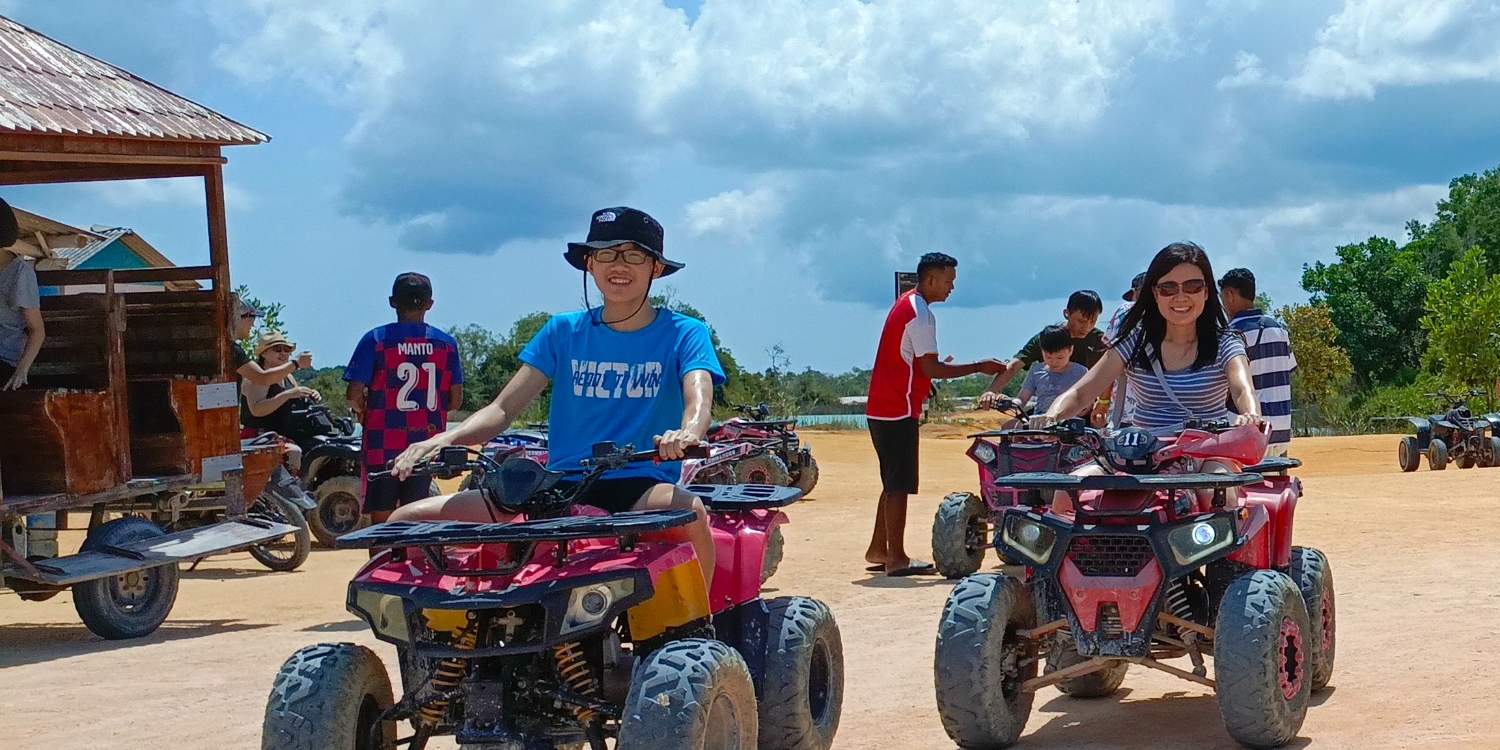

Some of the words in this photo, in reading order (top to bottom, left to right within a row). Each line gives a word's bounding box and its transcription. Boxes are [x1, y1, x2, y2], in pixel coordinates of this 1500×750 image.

[397, 342, 433, 355] MANTO
[396, 362, 437, 411] 21
[571, 359, 662, 399] VICTOR
[1123, 432, 1139, 447] 11
